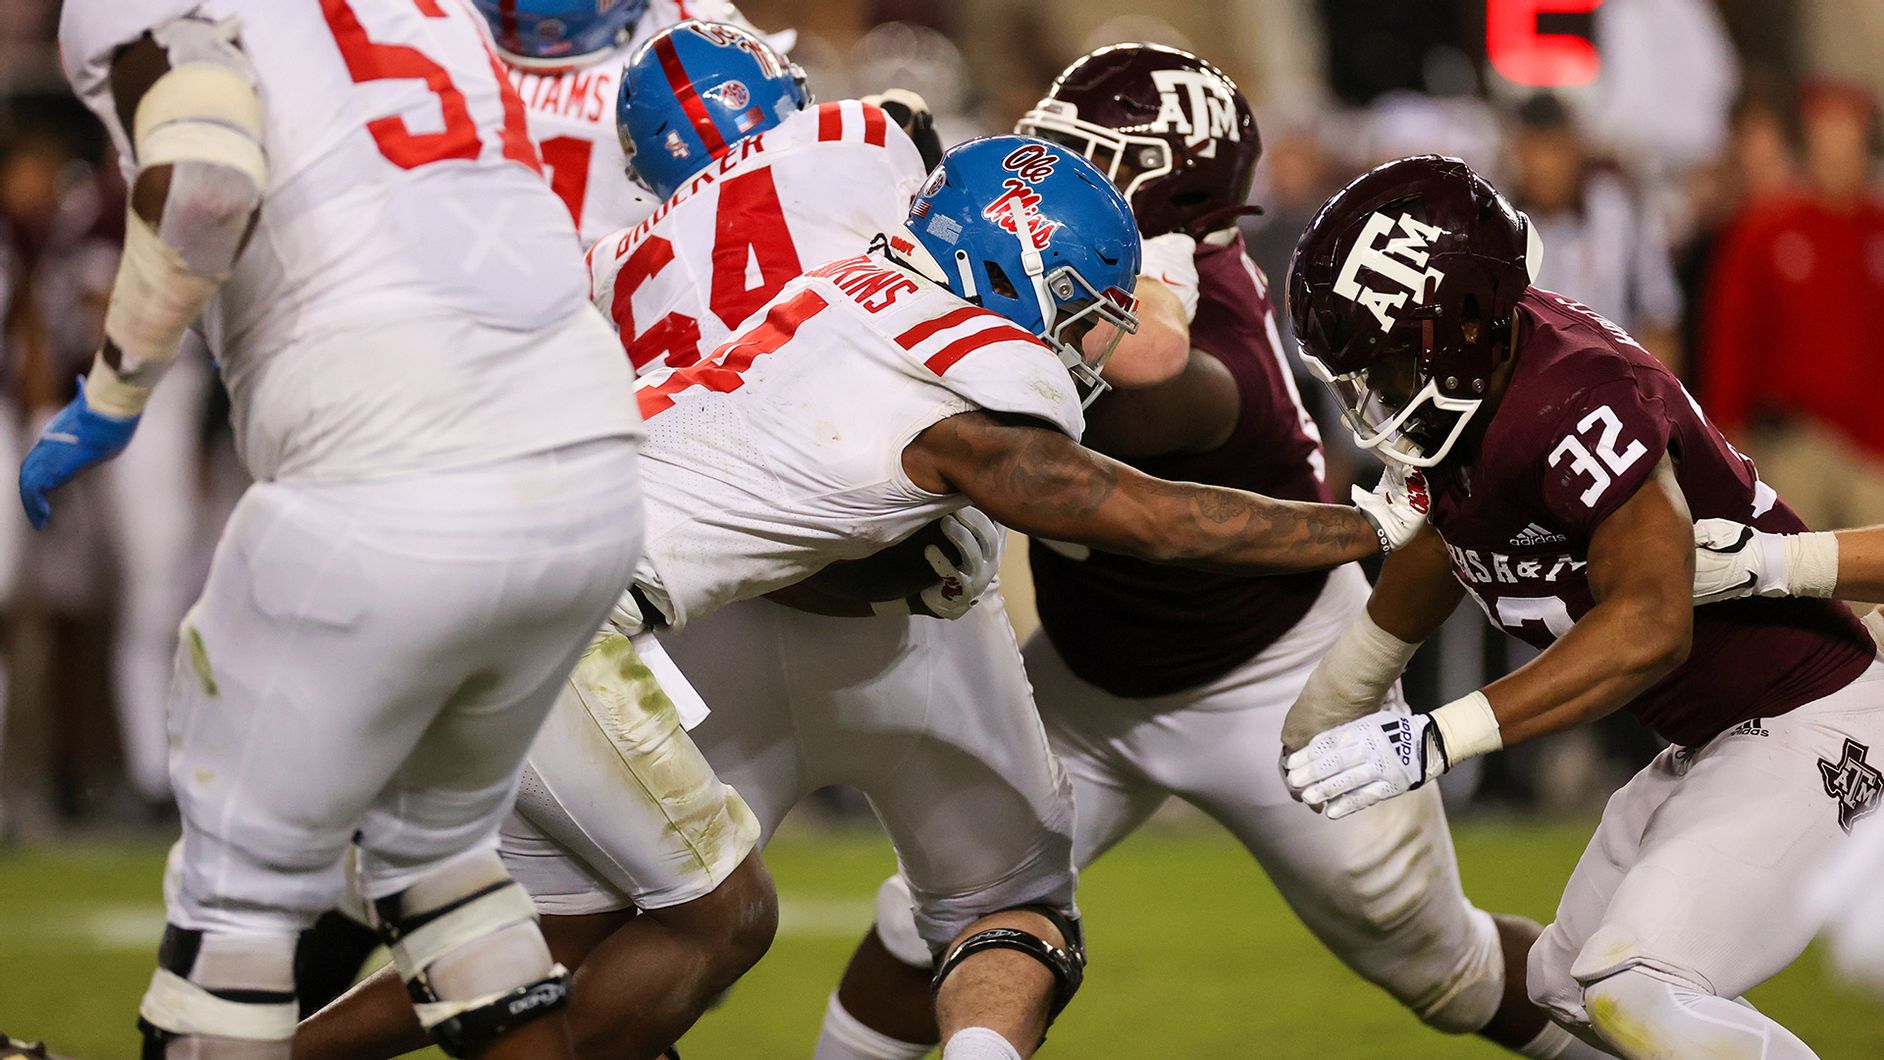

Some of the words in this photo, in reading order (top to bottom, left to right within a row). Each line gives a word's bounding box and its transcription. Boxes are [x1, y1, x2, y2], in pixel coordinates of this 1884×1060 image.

[1003, 145, 1060, 183] Ole
[611, 165, 804, 377] 64
[1548, 405, 1648, 508] 32
[1509, 532, 1567, 547] adidas
[1400, 717, 1412, 766] adidas
